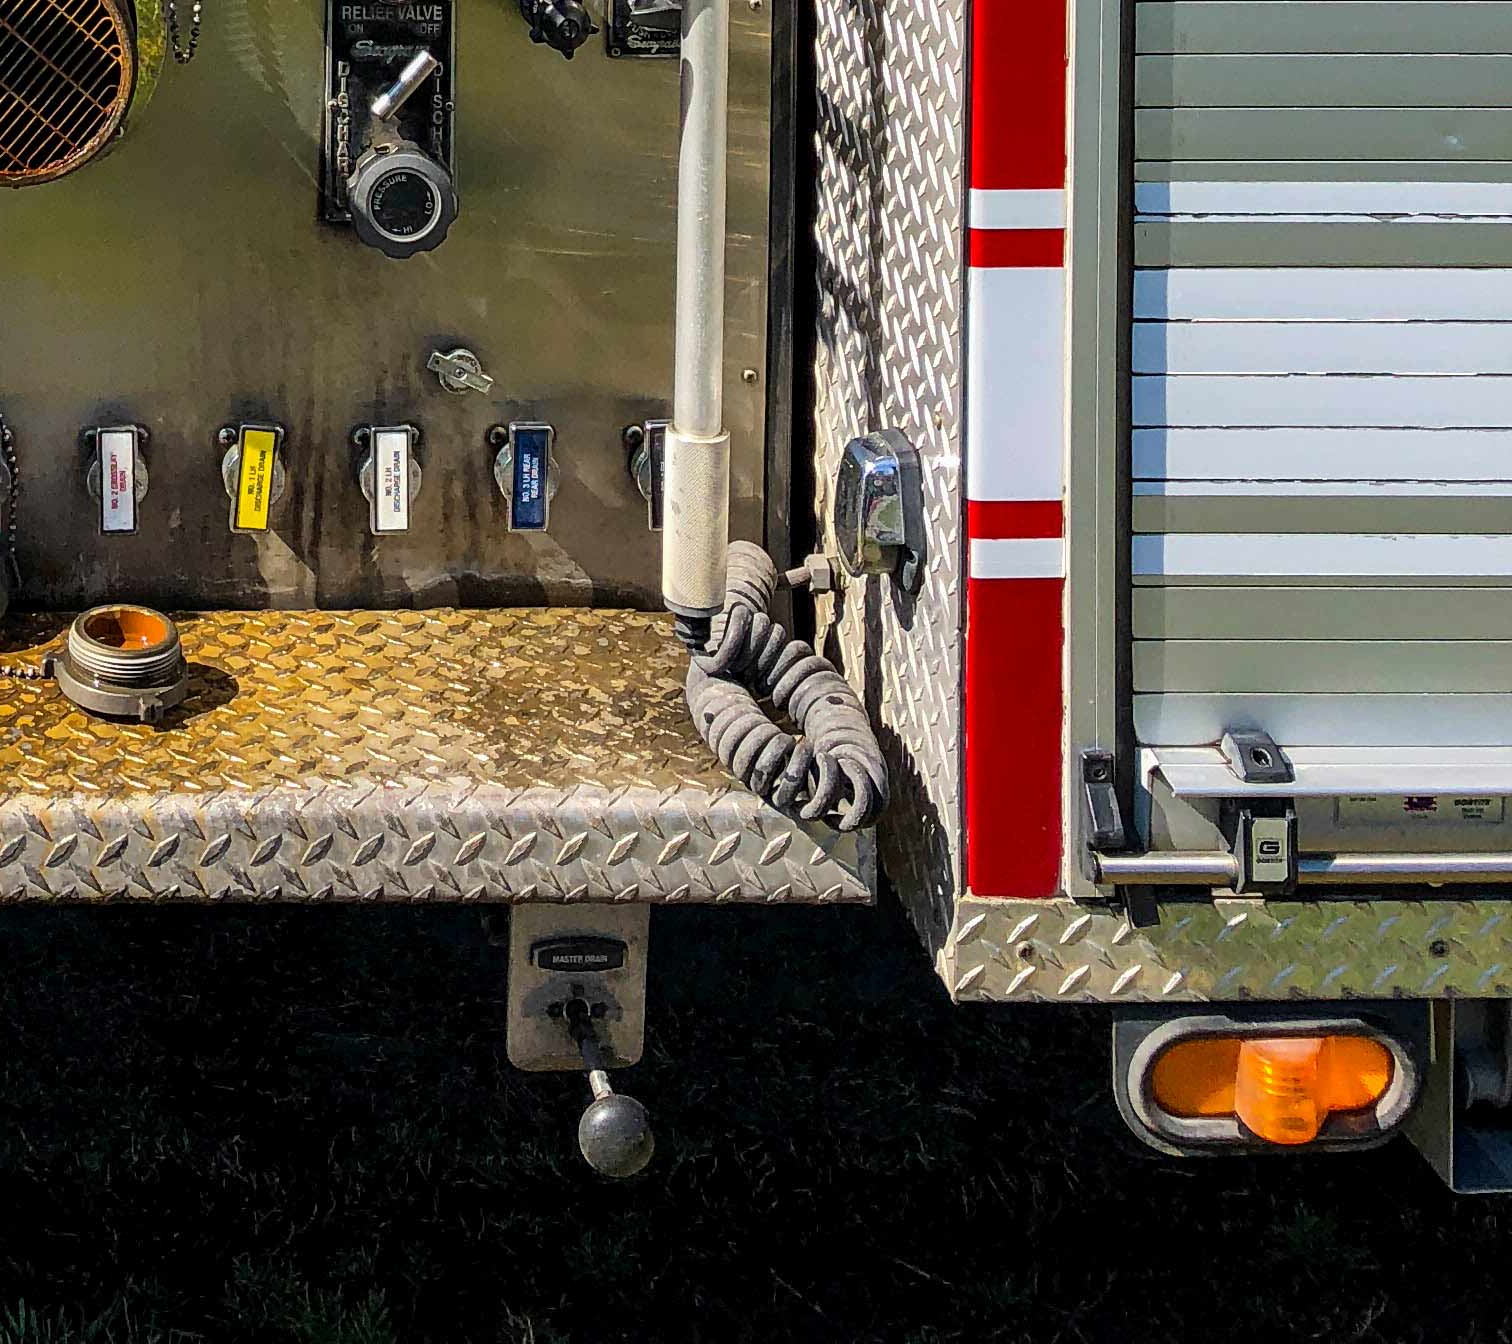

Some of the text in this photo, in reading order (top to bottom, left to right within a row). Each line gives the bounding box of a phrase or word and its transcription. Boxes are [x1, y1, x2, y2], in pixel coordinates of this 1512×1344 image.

[342, 5, 443, 21] RELIEF VALVE
[419, 23, 440, 34] OFF
[373, 174, 407, 211] PRESSURE
[393, 474, 401, 512] DISCHARGE
[1260, 841, 1280, 854] G
[552, 955, 583, 963] MASTER
